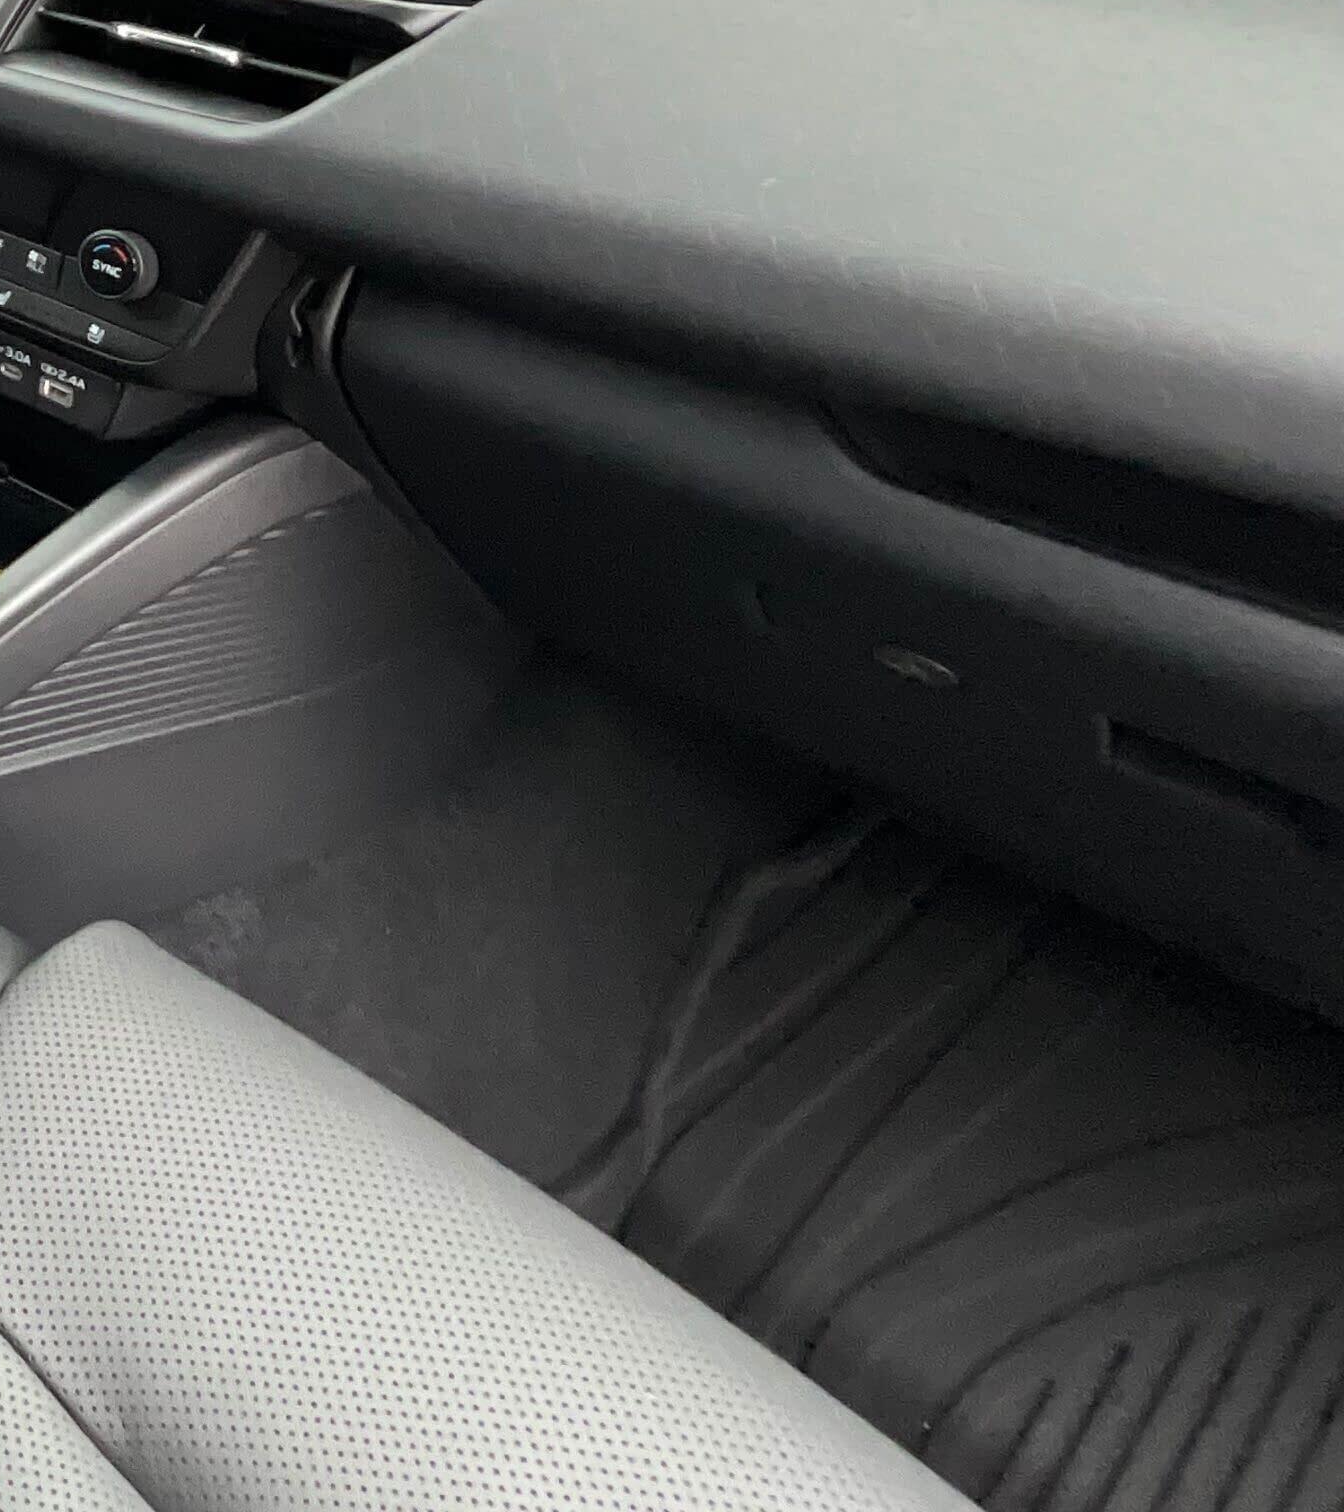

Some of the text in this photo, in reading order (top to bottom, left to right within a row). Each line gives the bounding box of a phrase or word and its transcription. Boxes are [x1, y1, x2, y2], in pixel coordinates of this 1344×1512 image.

[92, 258, 123, 279] SYNC
[4, 345, 32, 367] 3.0A
[57, 368, 86, 390] 2.4A
